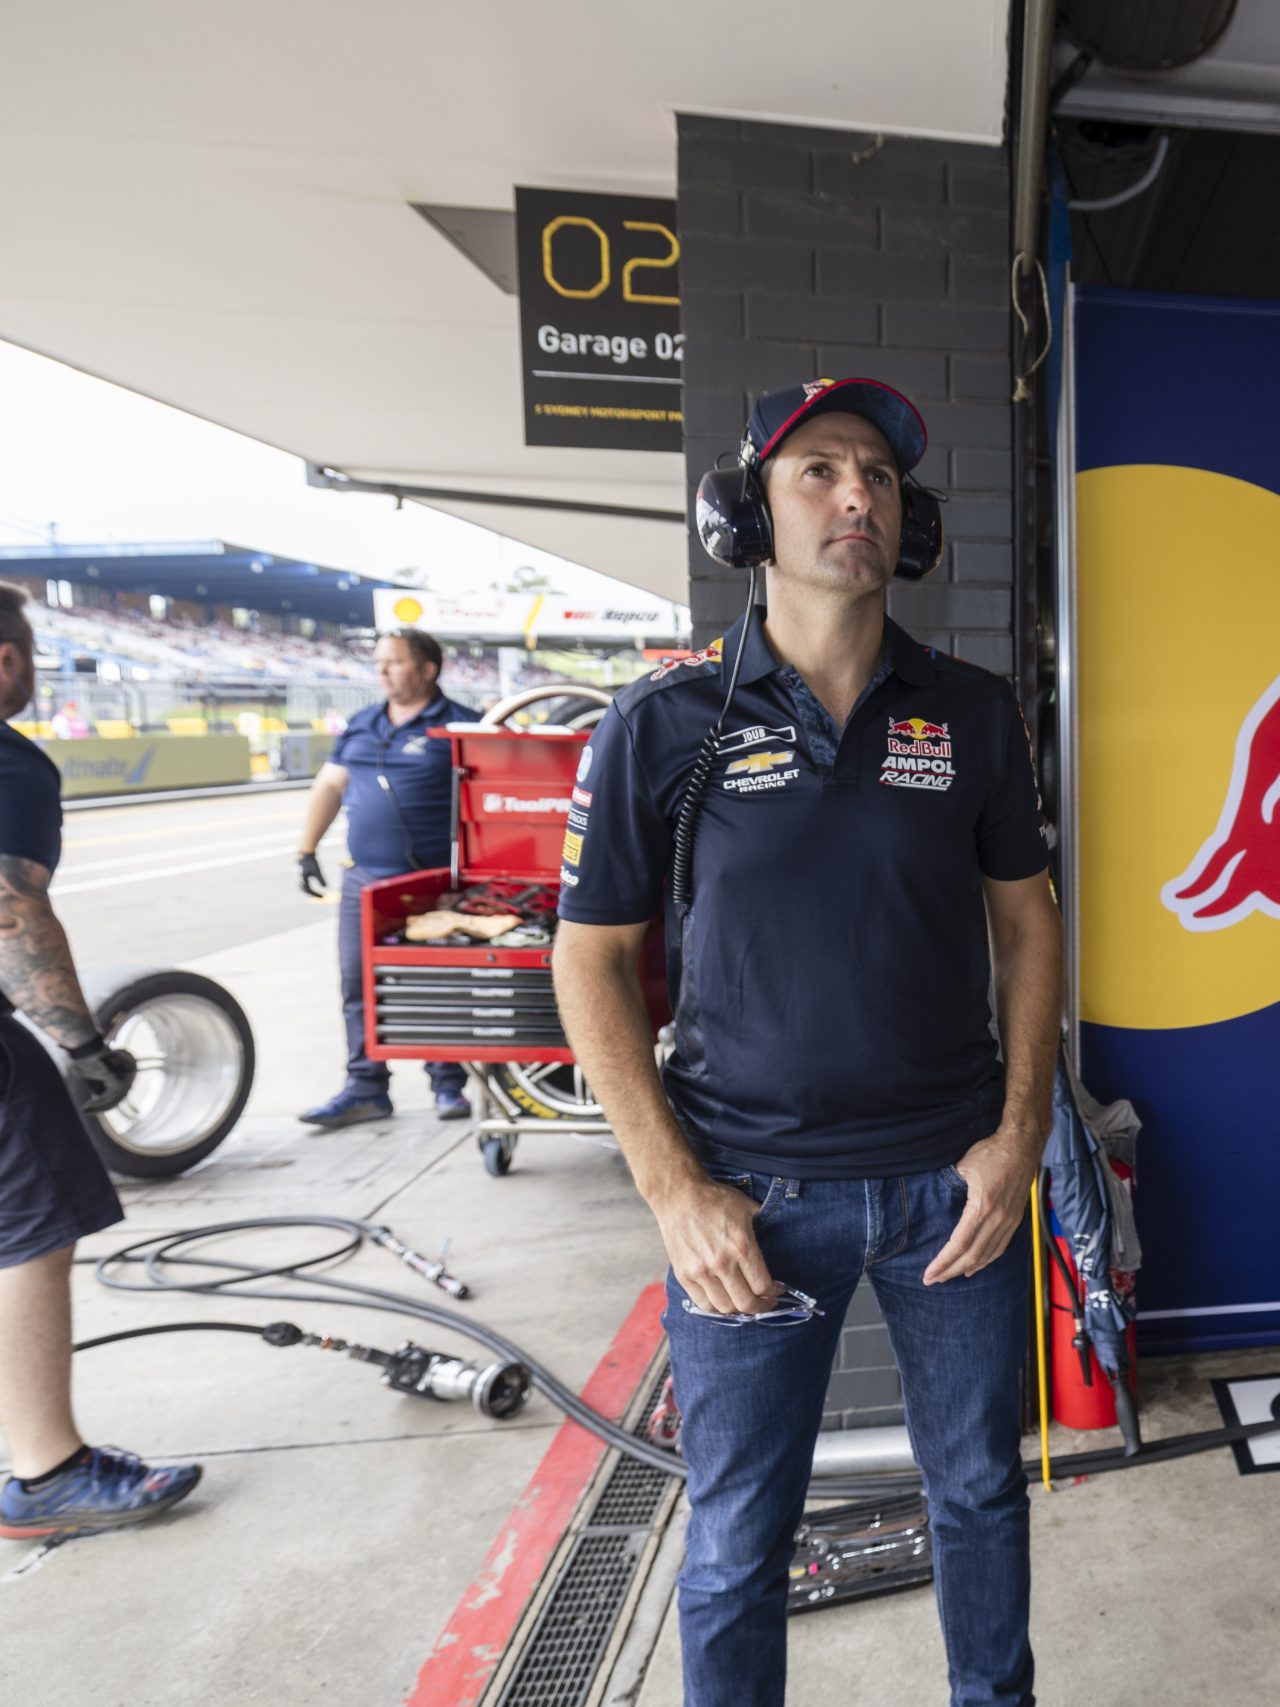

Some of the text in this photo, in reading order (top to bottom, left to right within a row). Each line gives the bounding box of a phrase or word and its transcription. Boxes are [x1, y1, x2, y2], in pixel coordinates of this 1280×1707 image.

[542, 215, 681, 305] 02
[537, 325, 648, 364] Garage
[742, 728, 766, 743] JDUB
[887, 737, 952, 758] Red Bull
[881, 755, 956, 775] AMPOL
[723, 768, 800, 790] CHEVROLET
[739, 780, 786, 793] RACING
[879, 770, 953, 787] RACING
